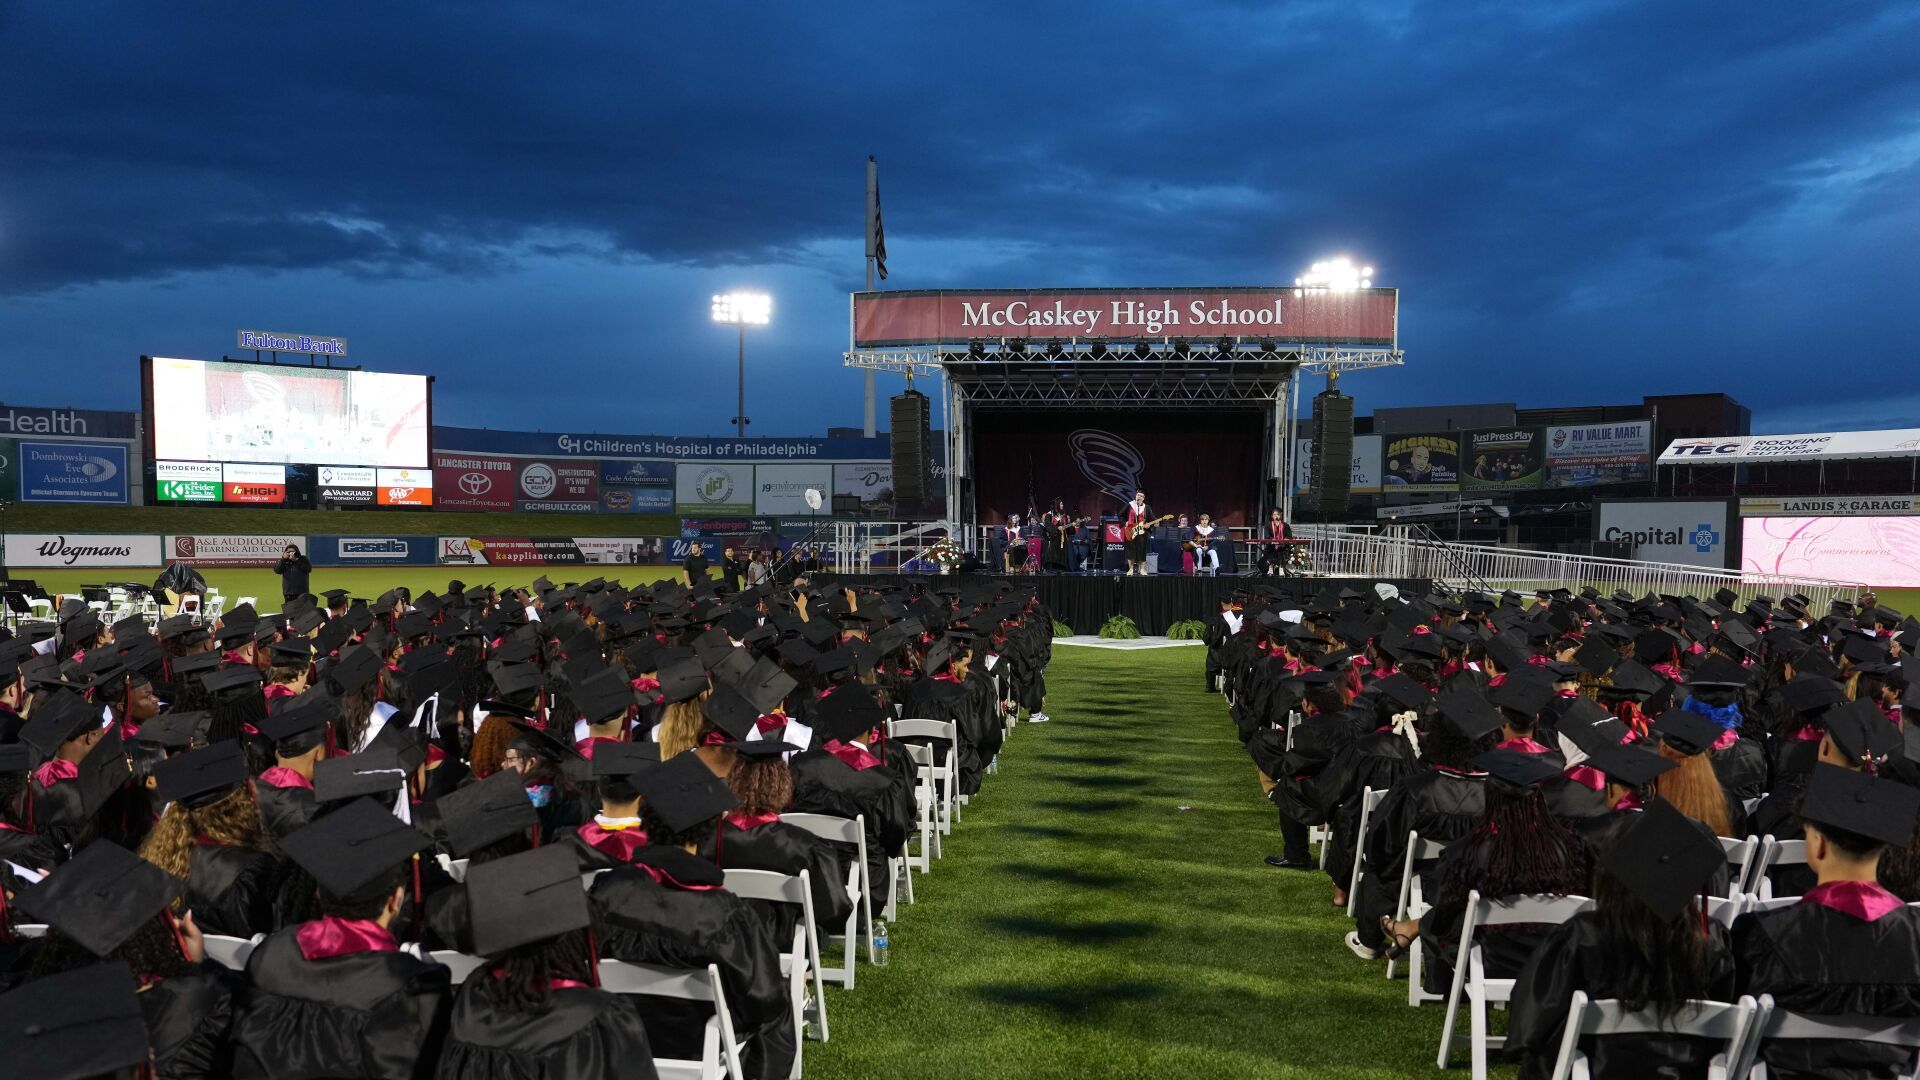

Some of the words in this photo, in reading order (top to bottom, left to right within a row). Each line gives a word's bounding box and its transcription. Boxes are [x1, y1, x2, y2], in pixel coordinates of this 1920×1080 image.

[961, 300, 1103, 333] McCaskey
[1110, 300, 1180, 334] High
[1188, 299, 1282, 326] School
[242, 331, 298, 350] Fulton
[299, 336, 344, 354] Bank
[0, 409, 87, 434] Health
[1472, 433, 1489, 442] Just
[1490, 432, 1513, 441] Press
[1514, 430, 1534, 441] Play
[1572, 429, 1584, 441] RV
[1586, 428, 1612, 441] VALUE
[1614, 426, 1642, 439] MART
[1753, 436, 1832, 445] ROOFING
[583, 439, 652, 453] Children's
[655, 442, 712, 457] Hospital
[716, 443, 731, 455] of
[734, 443, 817, 457] Philadelphia
[1672, 444, 1742, 455] TEC
[1746, 448, 1823, 456] GUTTERS
[31, 450, 87, 462] Dombrowski
[65, 463, 81, 473] Eye
[437, 458, 482, 470] LANCASTER
[483, 460, 511, 471] TOYOTA
[557, 468, 597, 478] CONSTRUCTION,
[42, 474, 88, 484] Associates
[605, 474, 622, 482] Code
[624, 474, 669, 483] Administrators
[244, 487, 277, 495] HIGH
[331, 489, 373, 497] VANGUARD
[569, 486, 577, 494] WE
[439, 497, 510, 507] LancasterToyota.com
[525, 503, 591, 511] GCMBUILT.COM
[1783, 501, 1834, 511] LANDIS
[1850, 500, 1911, 510] GARAGE
[196, 537, 219, 546] A&E
[220, 537, 290, 546] AUDIOLOGY
[1605, 526, 1684, 549] Capital
[35, 535, 131, 565] Wegmans
[196, 545, 239, 553] HEARING
[241, 545, 258, 553] AID
[261, 545, 285, 553] CENT
[343, 540, 406, 552] casella
[444, 539, 472, 555] K&A
[495, 552, 575, 562] kaappliance.com
